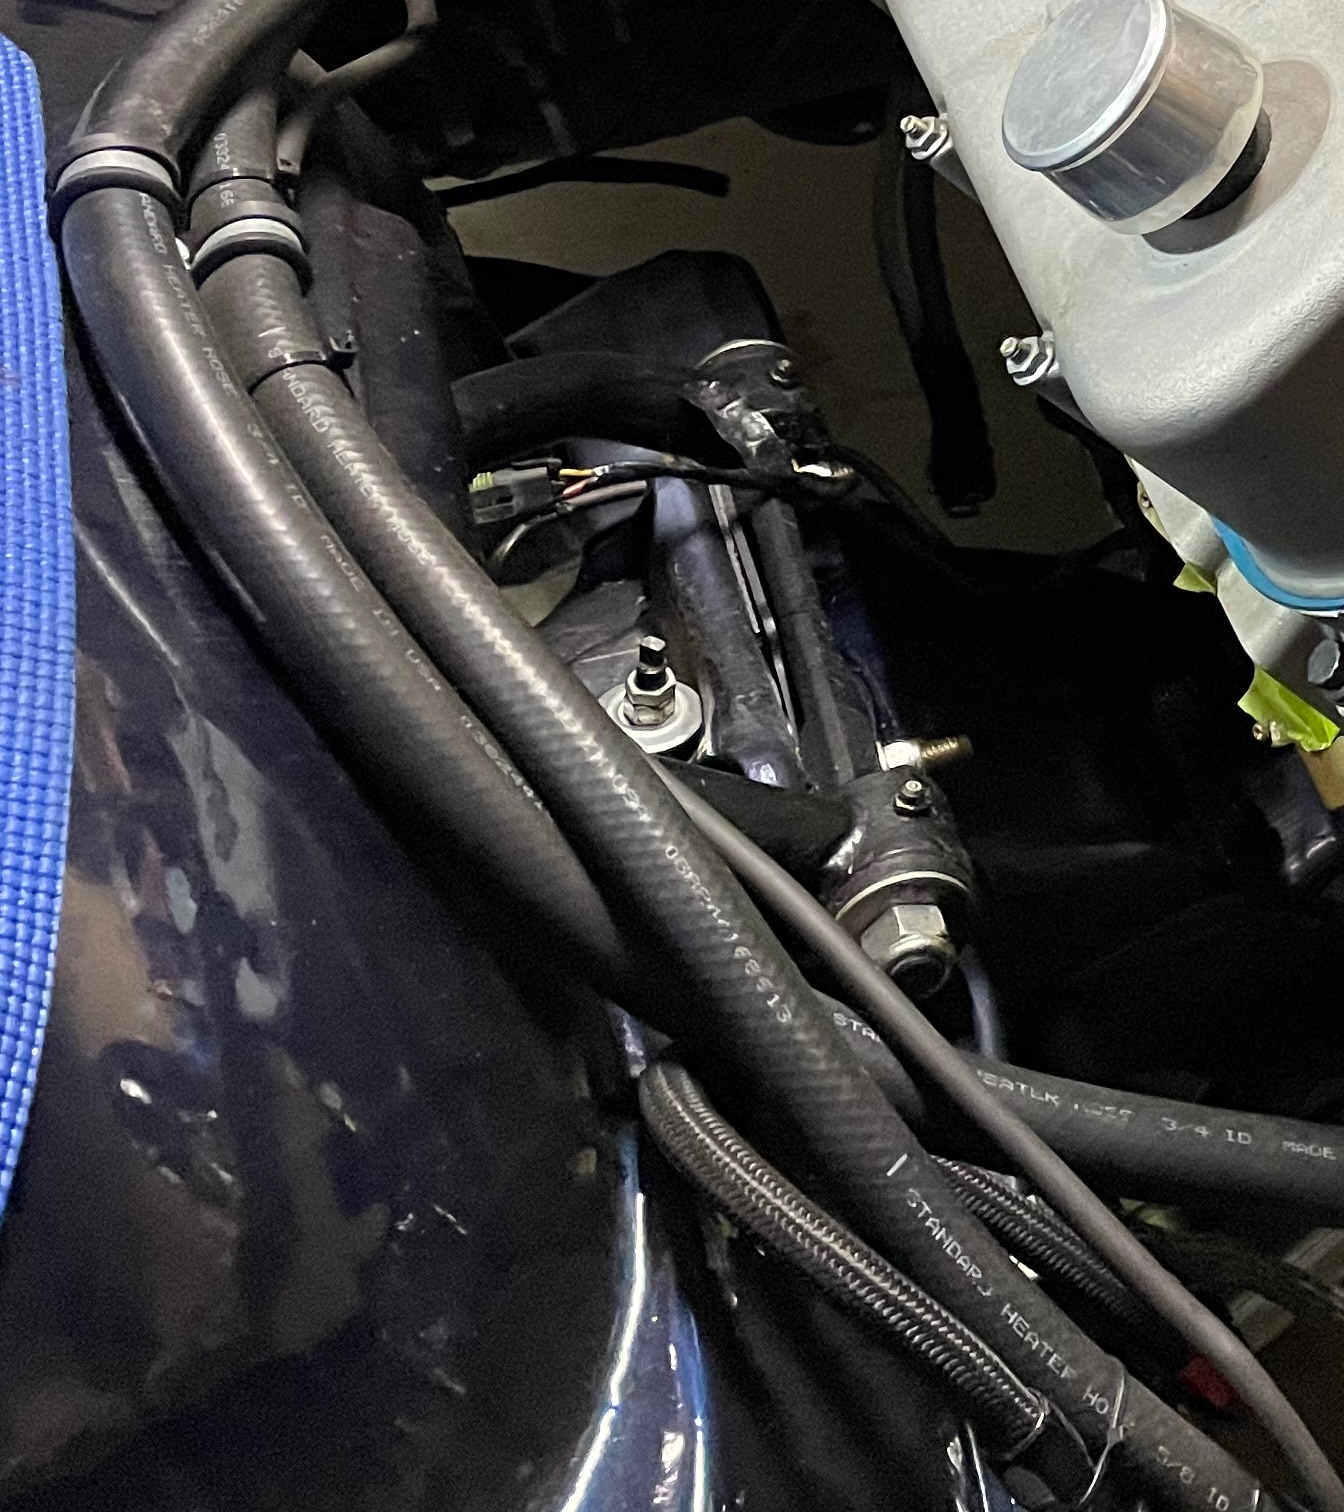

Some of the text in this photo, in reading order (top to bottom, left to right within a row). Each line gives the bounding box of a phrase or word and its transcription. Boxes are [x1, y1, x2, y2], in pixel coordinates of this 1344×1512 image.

[202, 346, 238, 397] HOSE
[268, 346, 330, 434] SANDARD
[1225, 1128, 1253, 1145] ID
[1282, 1139, 1338, 1162] MADE
